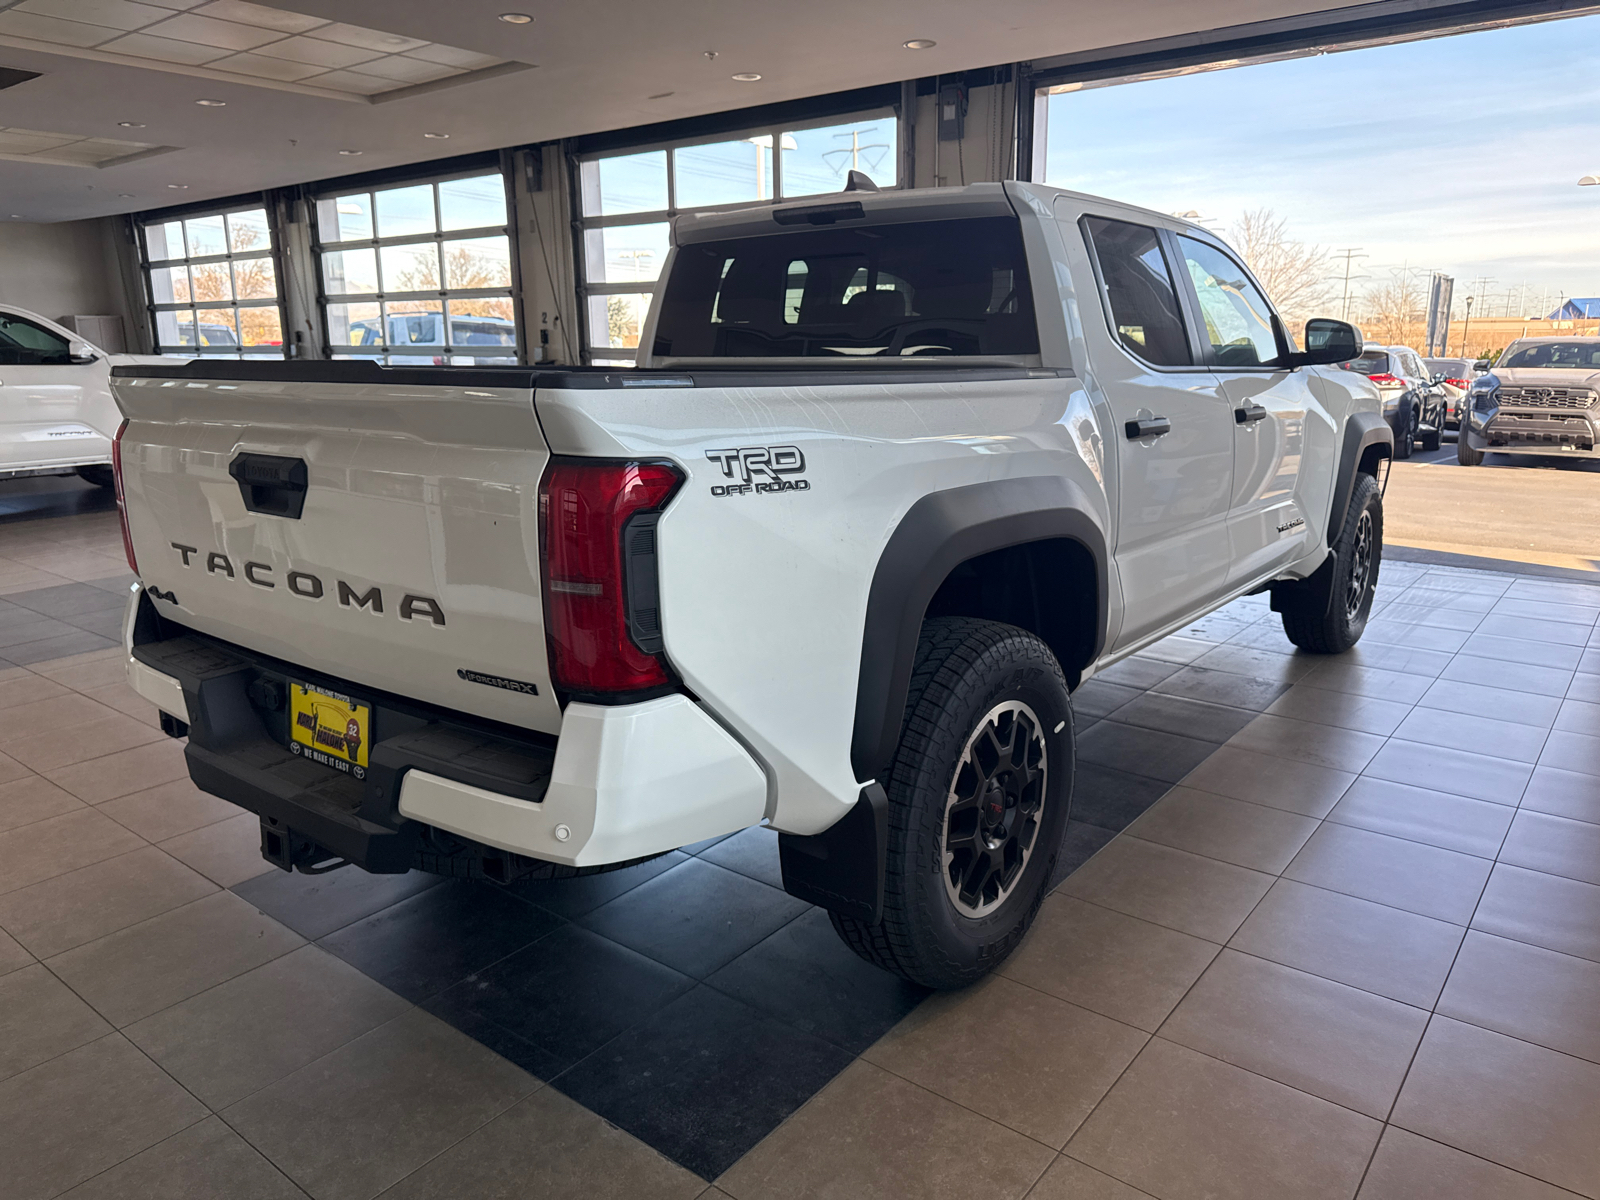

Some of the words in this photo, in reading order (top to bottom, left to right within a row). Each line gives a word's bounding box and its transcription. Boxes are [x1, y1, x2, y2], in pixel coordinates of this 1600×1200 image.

[542, 312, 548, 324] 2
[246, 465, 280, 479] TOYOTA
[705, 445, 806, 484] TRD
[711, 483, 753, 497] OFF
[755, 480, 811, 494] ROAD
[171, 542, 446, 628] TACOMA
[305, 683, 317, 692] KARL
[348, 724, 358, 737] 32
[303, 747, 313, 759] WE
[313, 750, 328, 765] MAKE
[328, 757, 335, 767] IT
[335, 759, 349, 773] EASY
